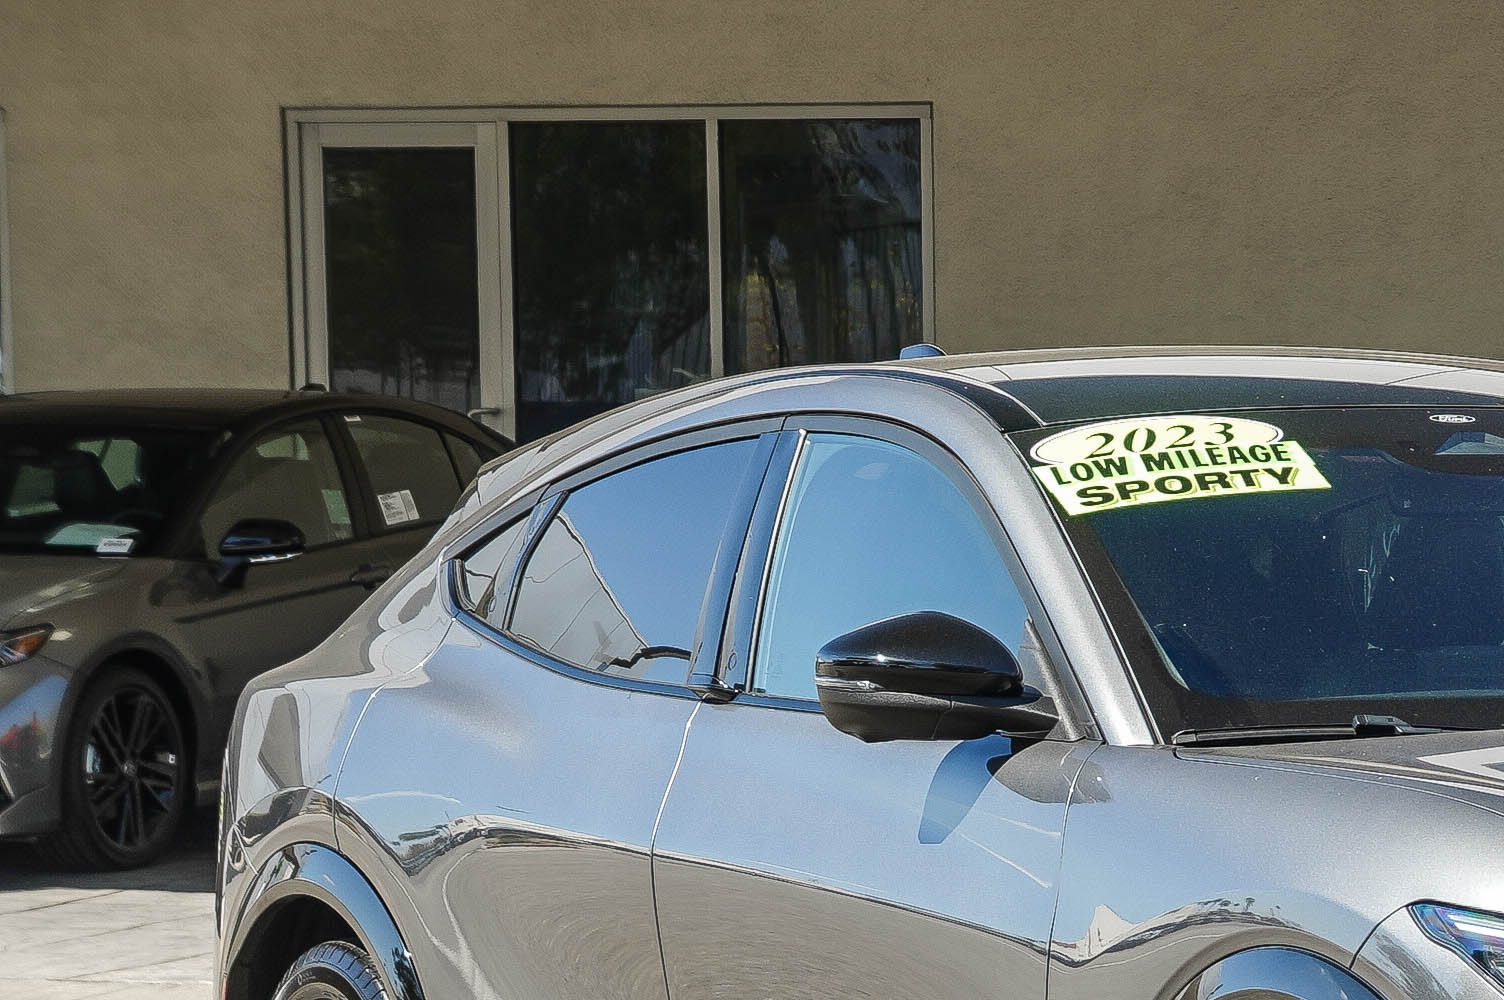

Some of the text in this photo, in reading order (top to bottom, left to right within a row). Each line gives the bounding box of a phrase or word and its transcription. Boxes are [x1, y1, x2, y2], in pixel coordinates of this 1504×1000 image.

[1085, 422, 1234, 459] 2023
[1050, 443, 1292, 485] LOW MILEAGE
[1076, 466, 1299, 507] SPORTY
